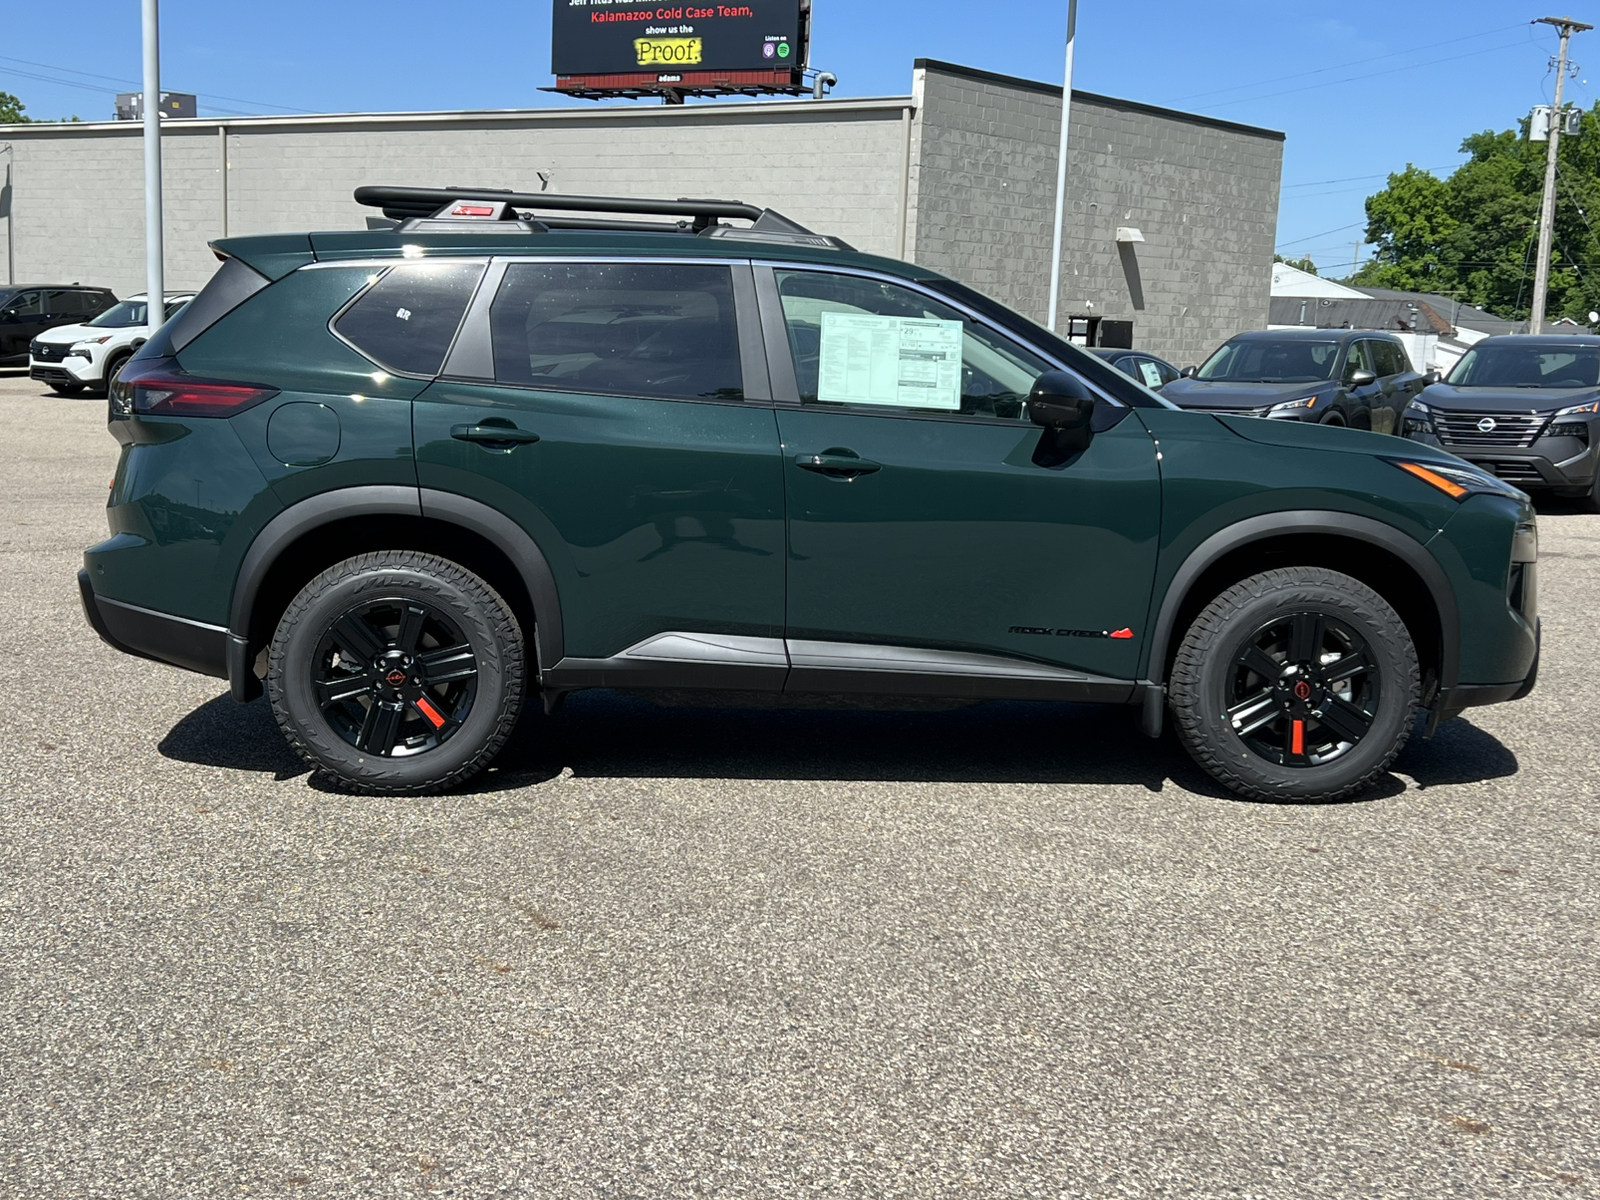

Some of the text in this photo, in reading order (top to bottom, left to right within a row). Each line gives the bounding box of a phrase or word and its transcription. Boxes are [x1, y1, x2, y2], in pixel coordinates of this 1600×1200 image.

[591, 5, 753, 23] Kalamazoo Cold Case Team,
[645, 25, 694, 35] show us the
[638, 39, 698, 61] Proof.
[658, 74, 680, 82] adams
[1008, 626, 1055, 636] ROCK
